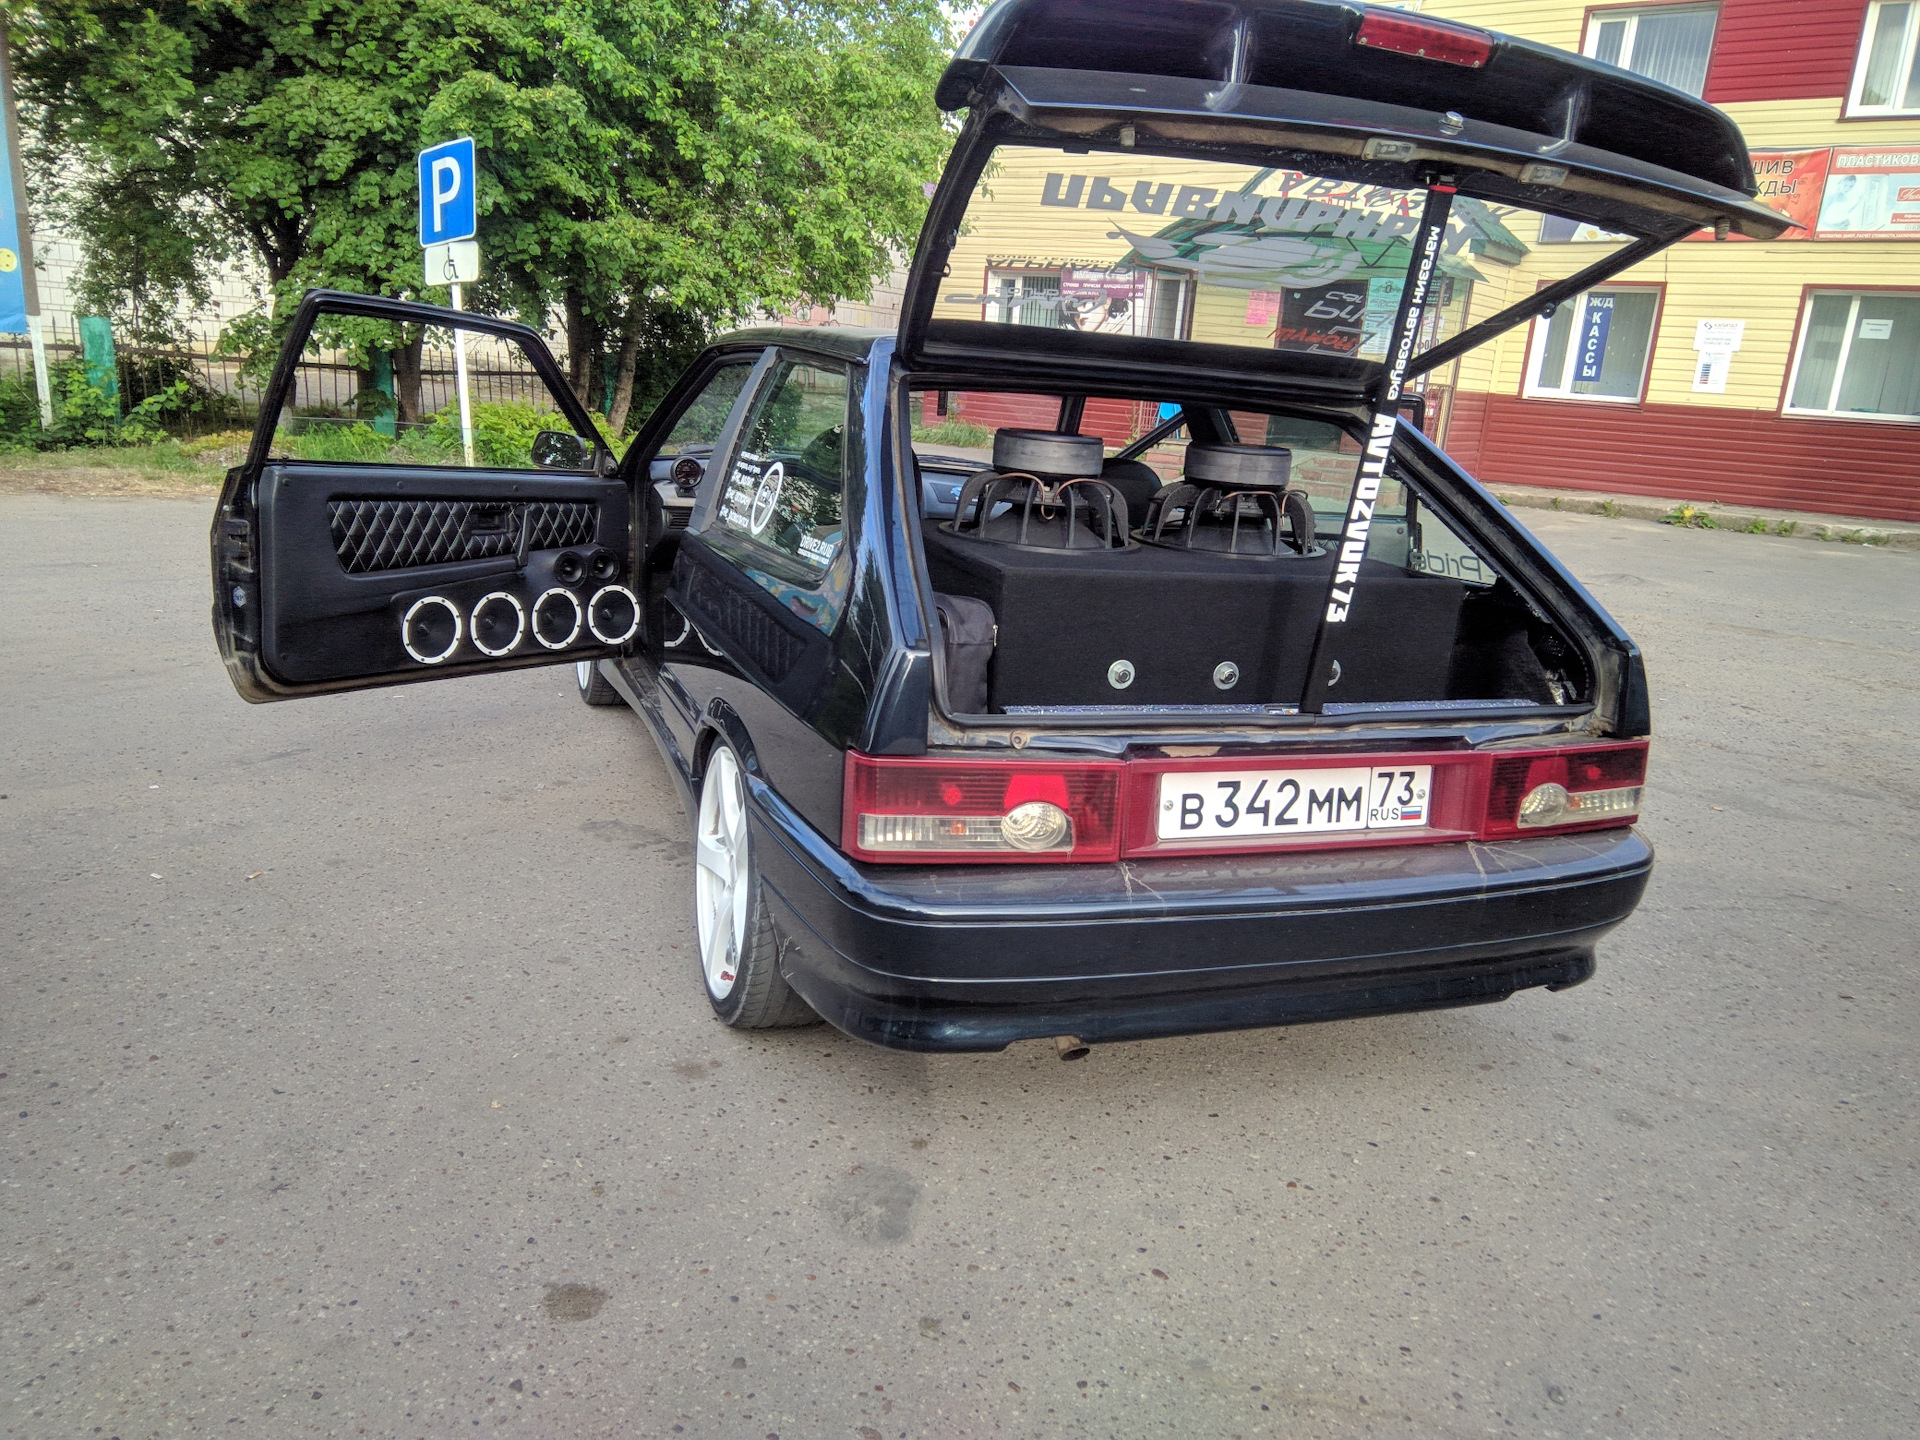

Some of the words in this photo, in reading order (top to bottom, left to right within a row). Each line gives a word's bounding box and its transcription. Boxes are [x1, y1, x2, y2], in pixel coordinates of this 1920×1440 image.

[431, 155, 462, 233] P
[1588, 296, 1614, 309] Ж/Д
[1386, 307, 1421, 401] автозвука
[1581, 311, 1602, 378] КАССЫ
[1335, 412, 1397, 585] AVTOZVUK
[1326, 586, 1354, 623] 73
[1369, 807, 1400, 821] RUS
[1377, 771, 1416, 808] 73
